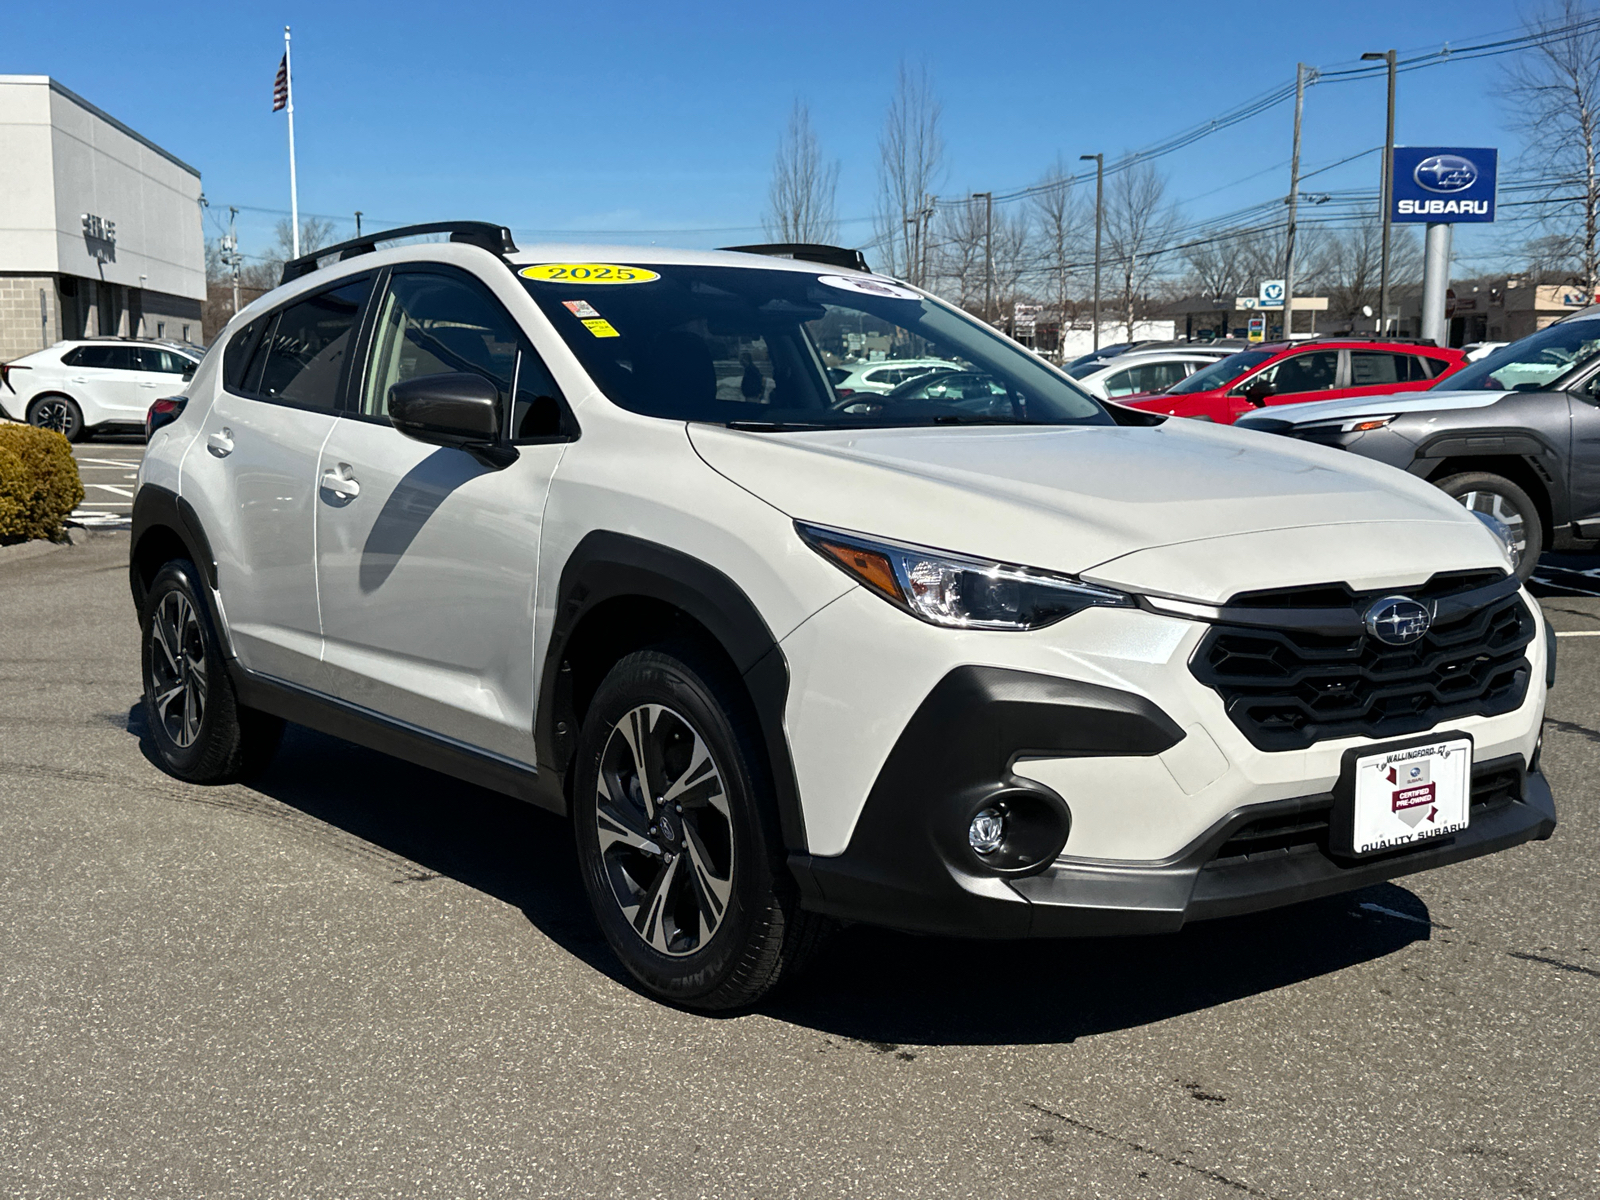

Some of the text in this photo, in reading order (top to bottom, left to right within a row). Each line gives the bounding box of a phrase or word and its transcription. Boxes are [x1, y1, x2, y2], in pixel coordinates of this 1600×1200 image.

[1398, 200, 1488, 214] SUBARU
[548, 267, 635, 280] 2025
[1399, 788, 1429, 799] CERTIFIED
[1396, 794, 1431, 807] PRE-OWNED
[1361, 822, 1465, 852] QUALITY SUBARU
